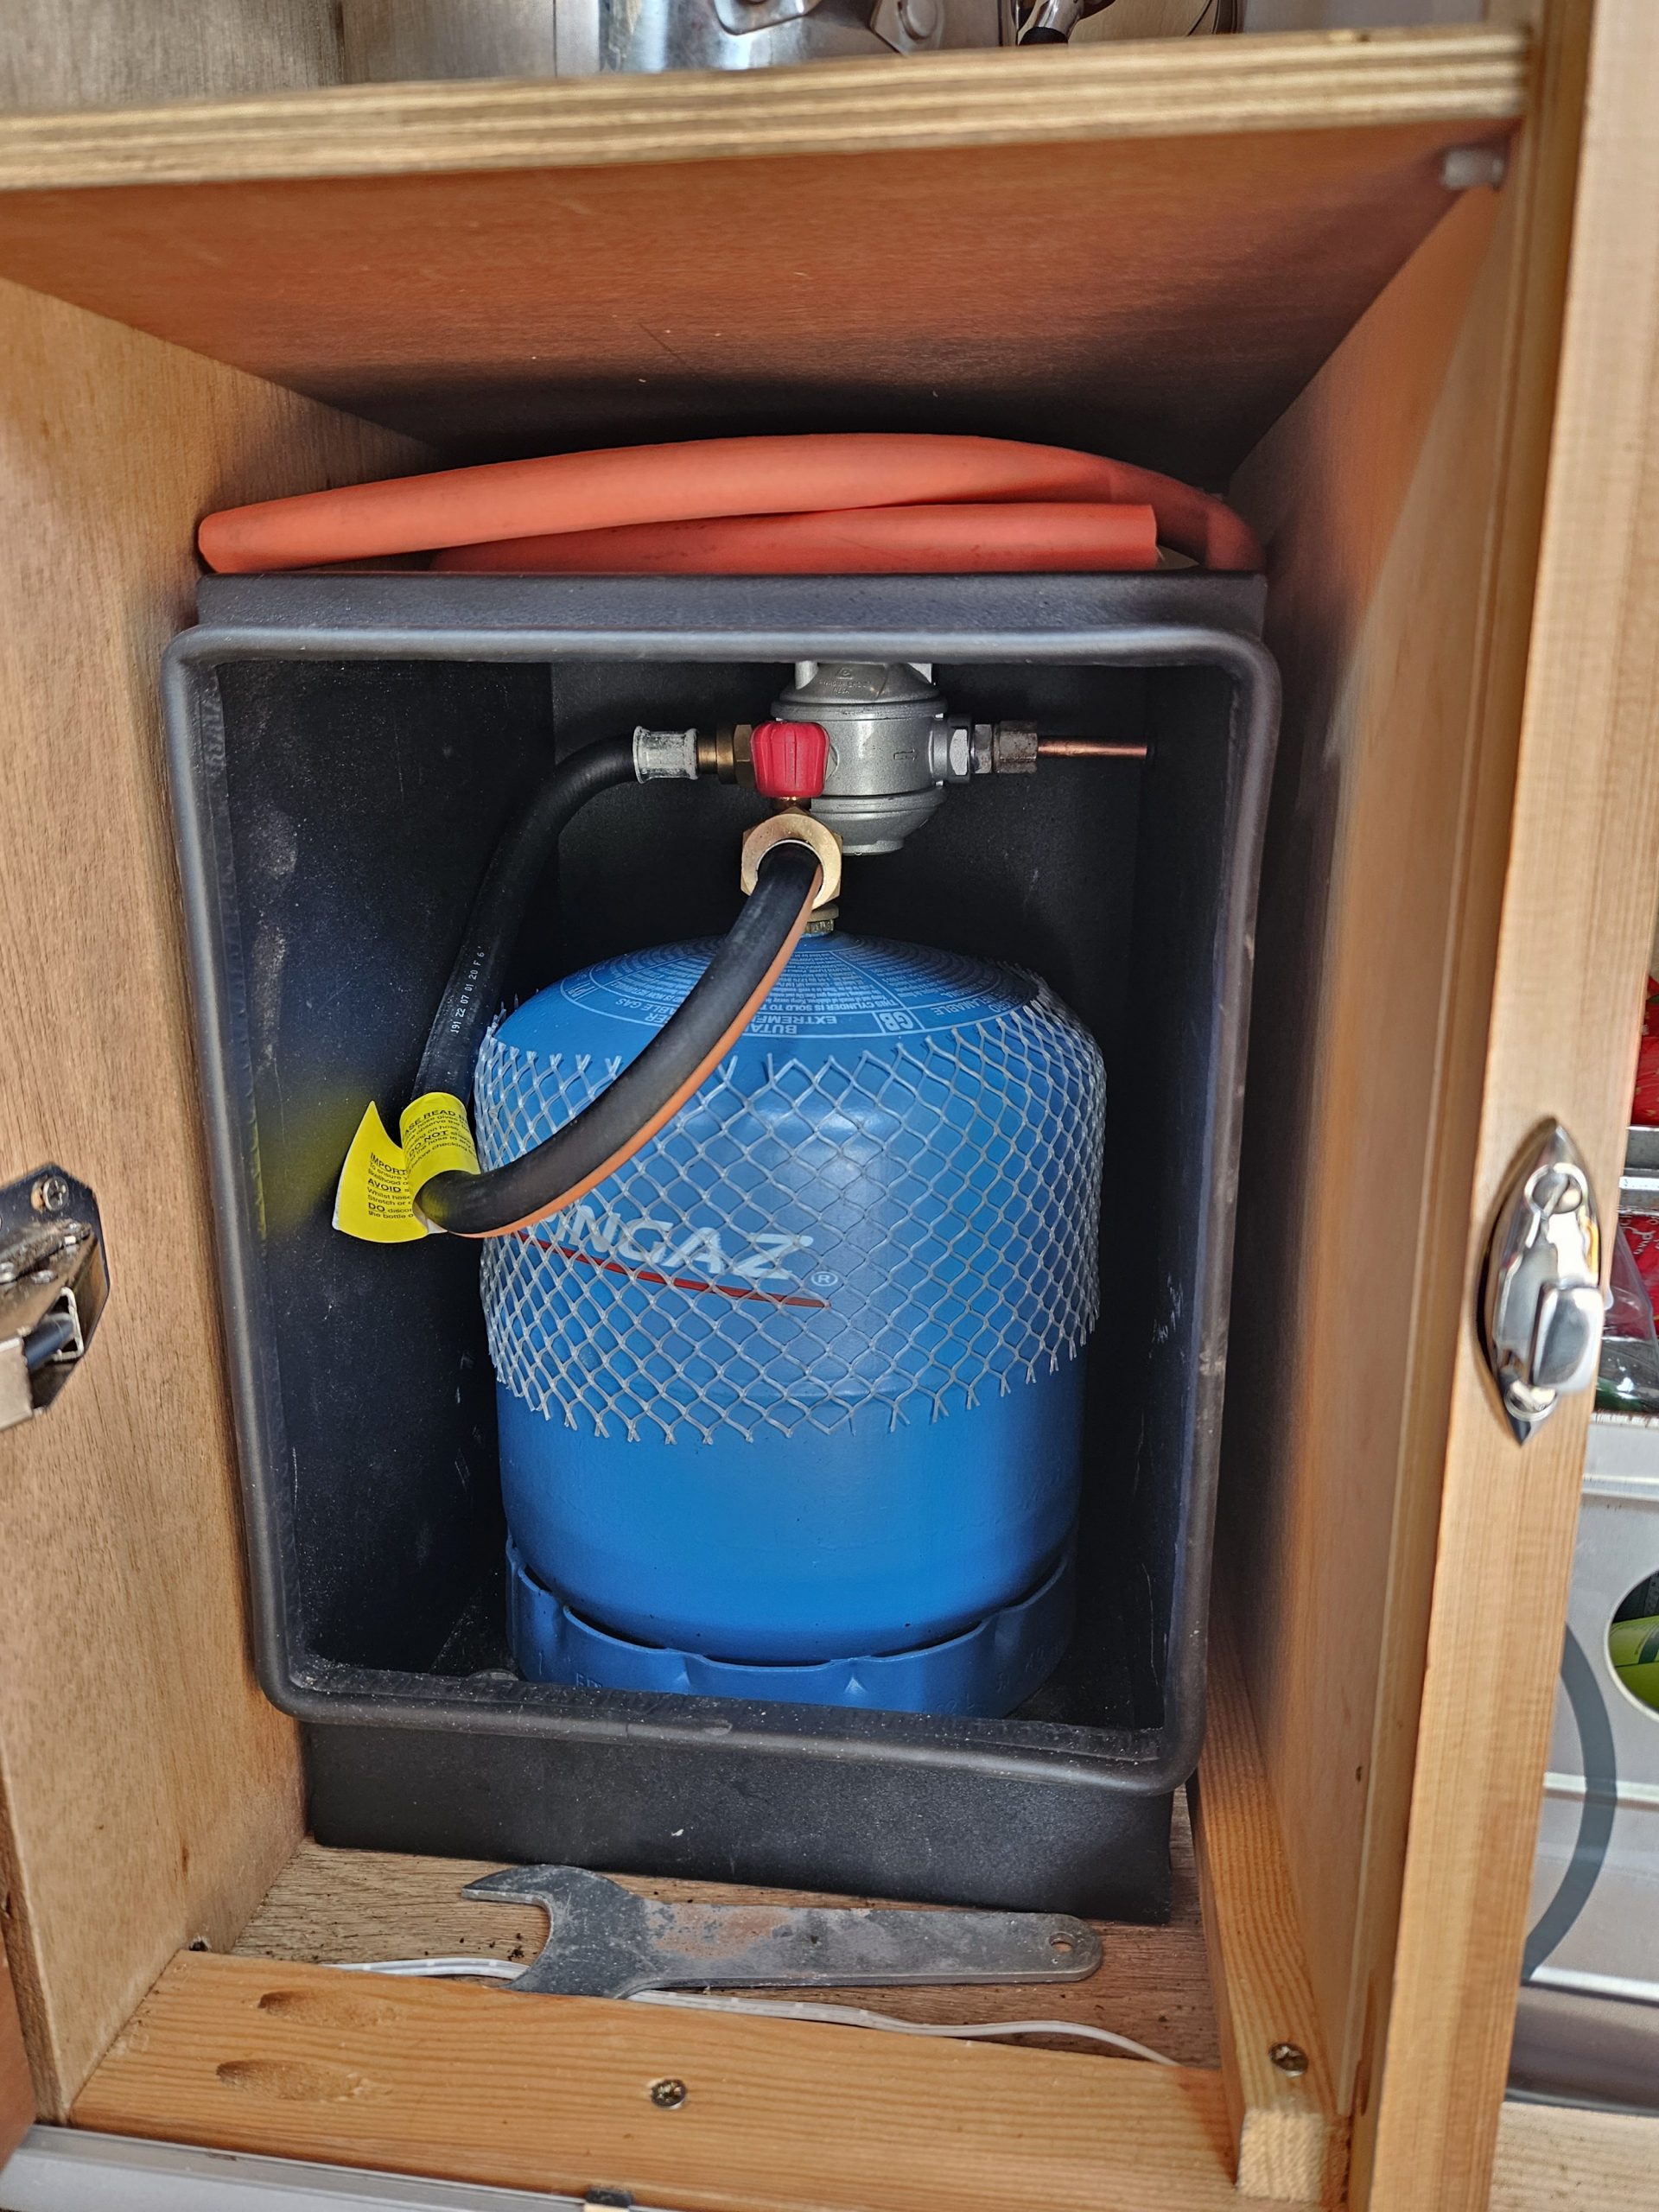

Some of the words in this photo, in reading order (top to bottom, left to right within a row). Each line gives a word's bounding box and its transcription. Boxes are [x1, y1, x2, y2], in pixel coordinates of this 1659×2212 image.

[460, 995, 470, 1004] 07
[468, 969, 479, 980] 20
[615, 998, 642, 1008] GAS
[826, 1001, 874, 1011] CYLINDER
[879, 1011, 914, 1032] GB
[423, 1109, 456, 1119] READ
[423, 1130, 449, 1143] NOT
[377, 1168, 402, 1180] ensure
[368, 1178, 402, 1192] AVOID
[367, 1186, 391, 1198] Whilst
[367, 1194, 396, 1205] Stretch
[368, 1202, 385, 1212] DO
[544, 1205, 813, 1280] INGAZ
